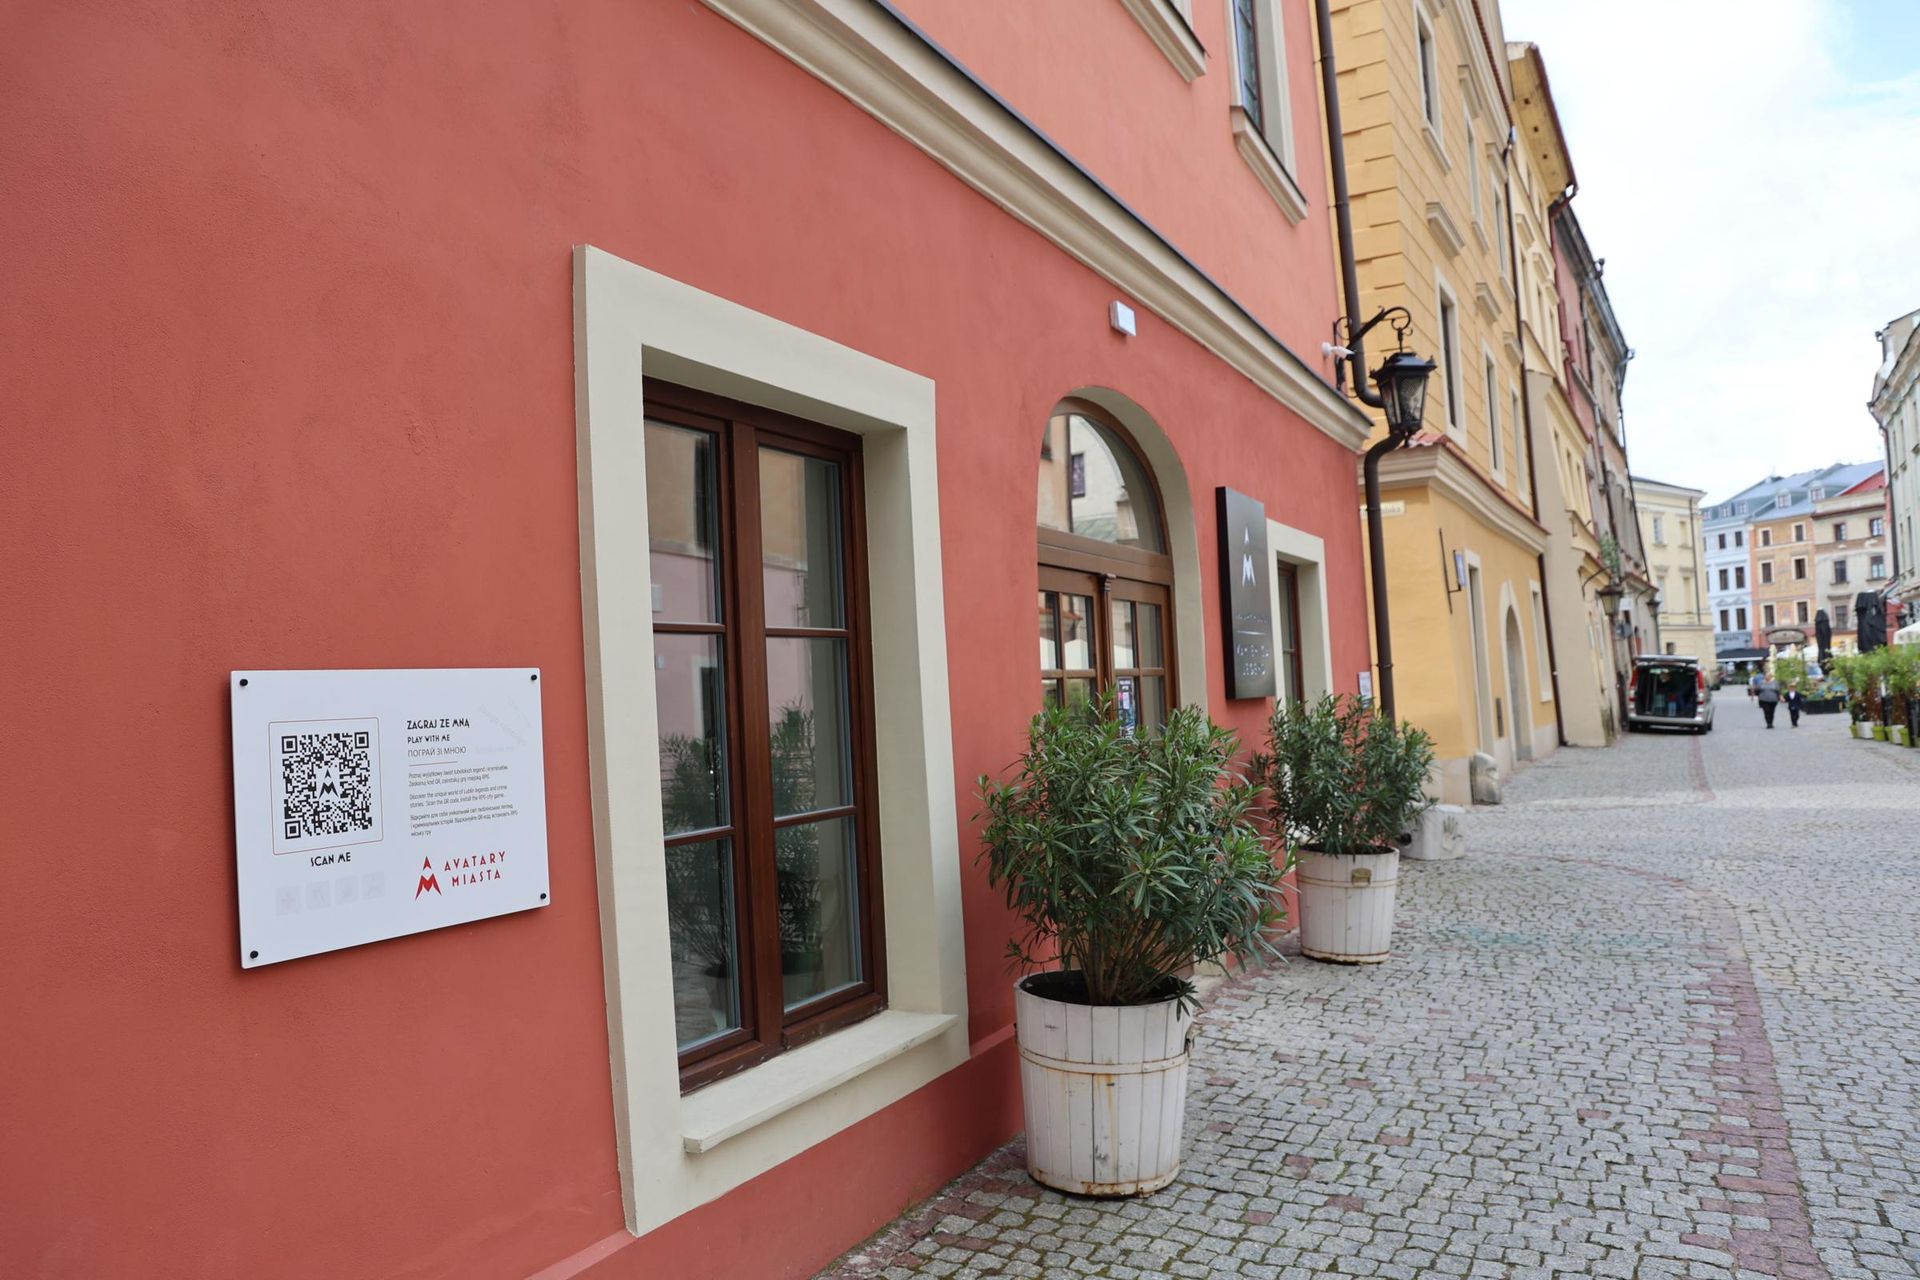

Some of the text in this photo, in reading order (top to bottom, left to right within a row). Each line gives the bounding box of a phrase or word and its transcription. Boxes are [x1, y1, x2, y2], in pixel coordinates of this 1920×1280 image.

[407, 717, 470, 730] ZAGRAJ ZE MNĄ
[407, 733, 451, 744] PLAY WITH ME
[408, 747, 436, 757] ПОГРАЙ
[443, 745, 467, 755] МНОЮ
[310, 851, 352, 867] SCAN ME
[444, 850, 506, 872] AVATARY
[452, 868, 501, 887] MIASTA
